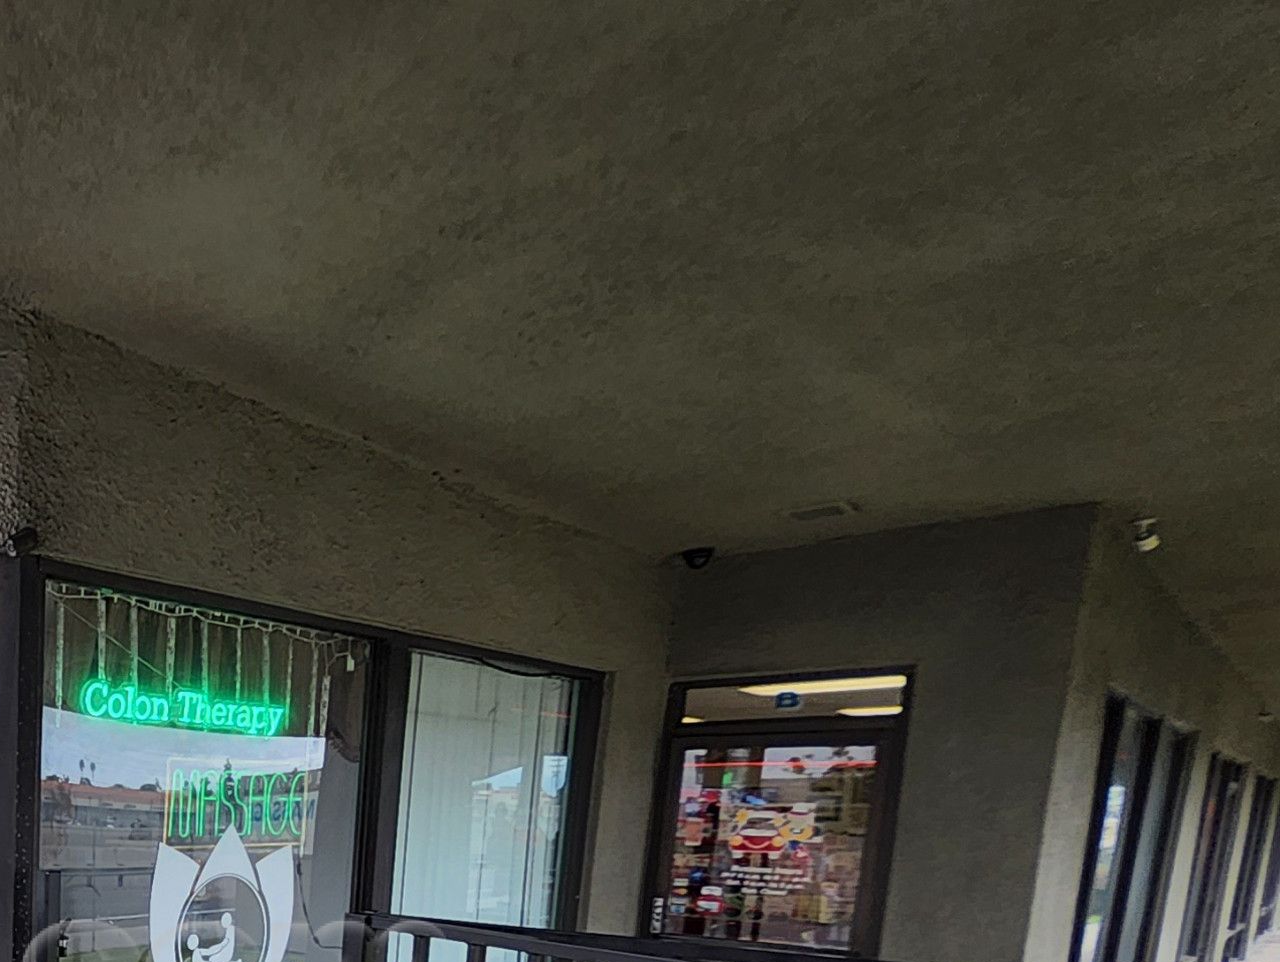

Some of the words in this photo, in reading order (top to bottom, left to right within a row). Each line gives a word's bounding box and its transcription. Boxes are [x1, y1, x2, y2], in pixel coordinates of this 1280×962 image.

[84, 681, 169, 722] Colon
[177, 690, 284, 736] Therapy
[168, 769, 306, 838] MASSAGE
